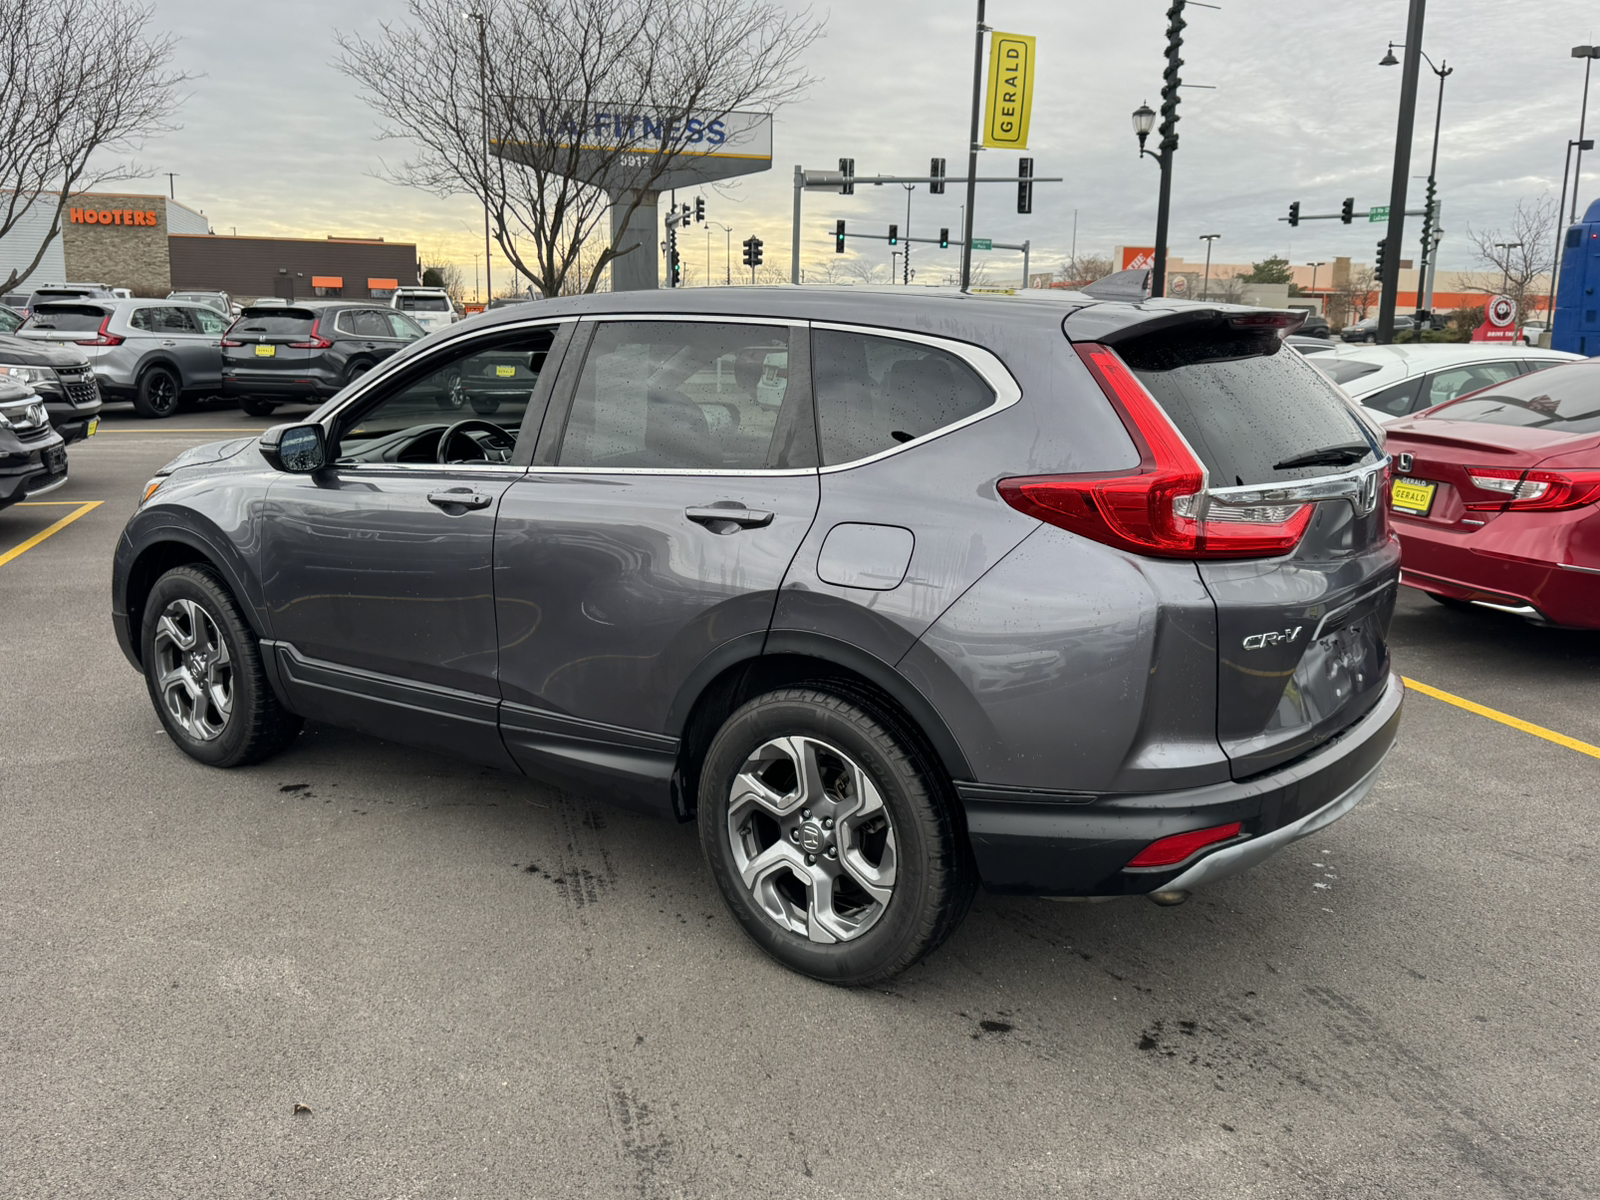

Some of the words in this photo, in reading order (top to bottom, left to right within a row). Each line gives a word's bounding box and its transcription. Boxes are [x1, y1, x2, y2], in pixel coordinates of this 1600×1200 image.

[1000, 48, 1019, 133] GERALD
[594, 113, 726, 145] FITNESS
[69, 207, 158, 227] HOOTERS
[1402, 477, 1427, 487] GERALD
[1395, 489, 1426, 502] GERALD
[1242, 625, 1303, 651] CR-V
